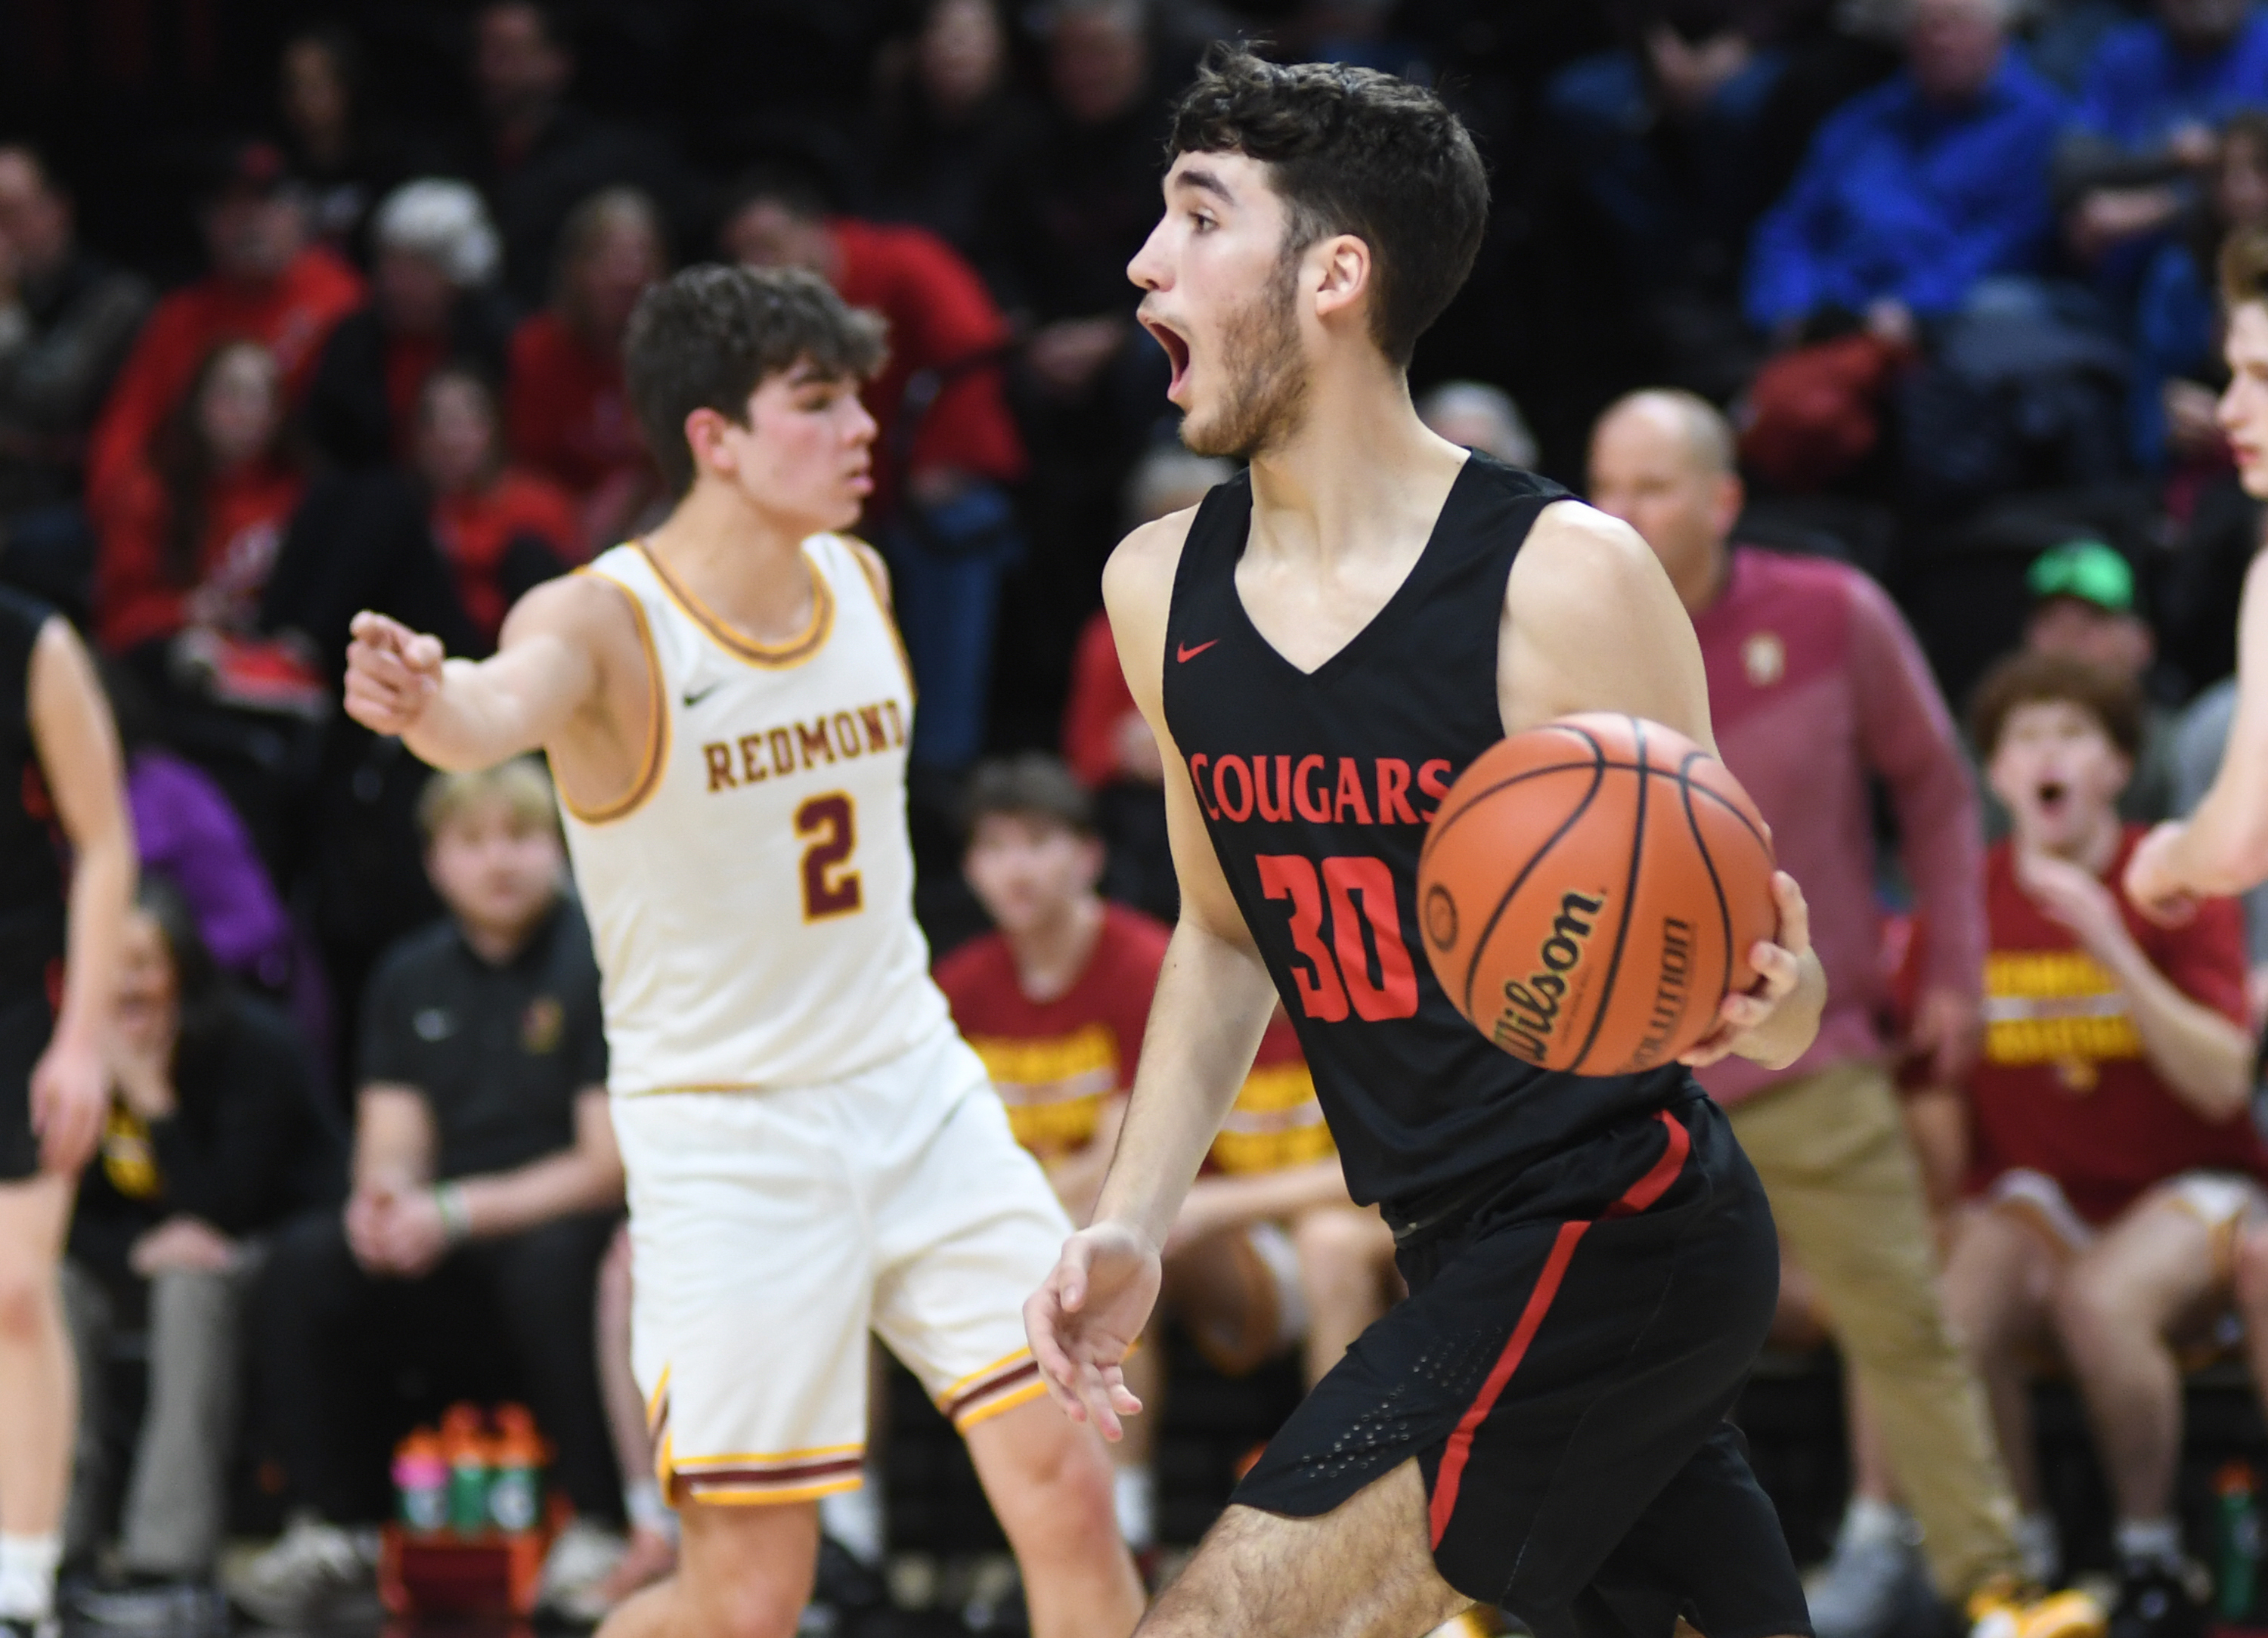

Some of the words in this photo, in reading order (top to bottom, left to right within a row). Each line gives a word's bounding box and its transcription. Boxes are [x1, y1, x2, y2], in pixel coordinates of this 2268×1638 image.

[792, 788, 865, 926] 2
[1190, 753, 1452, 825] COUGARS
[1255, 854, 1418, 1022] 30
